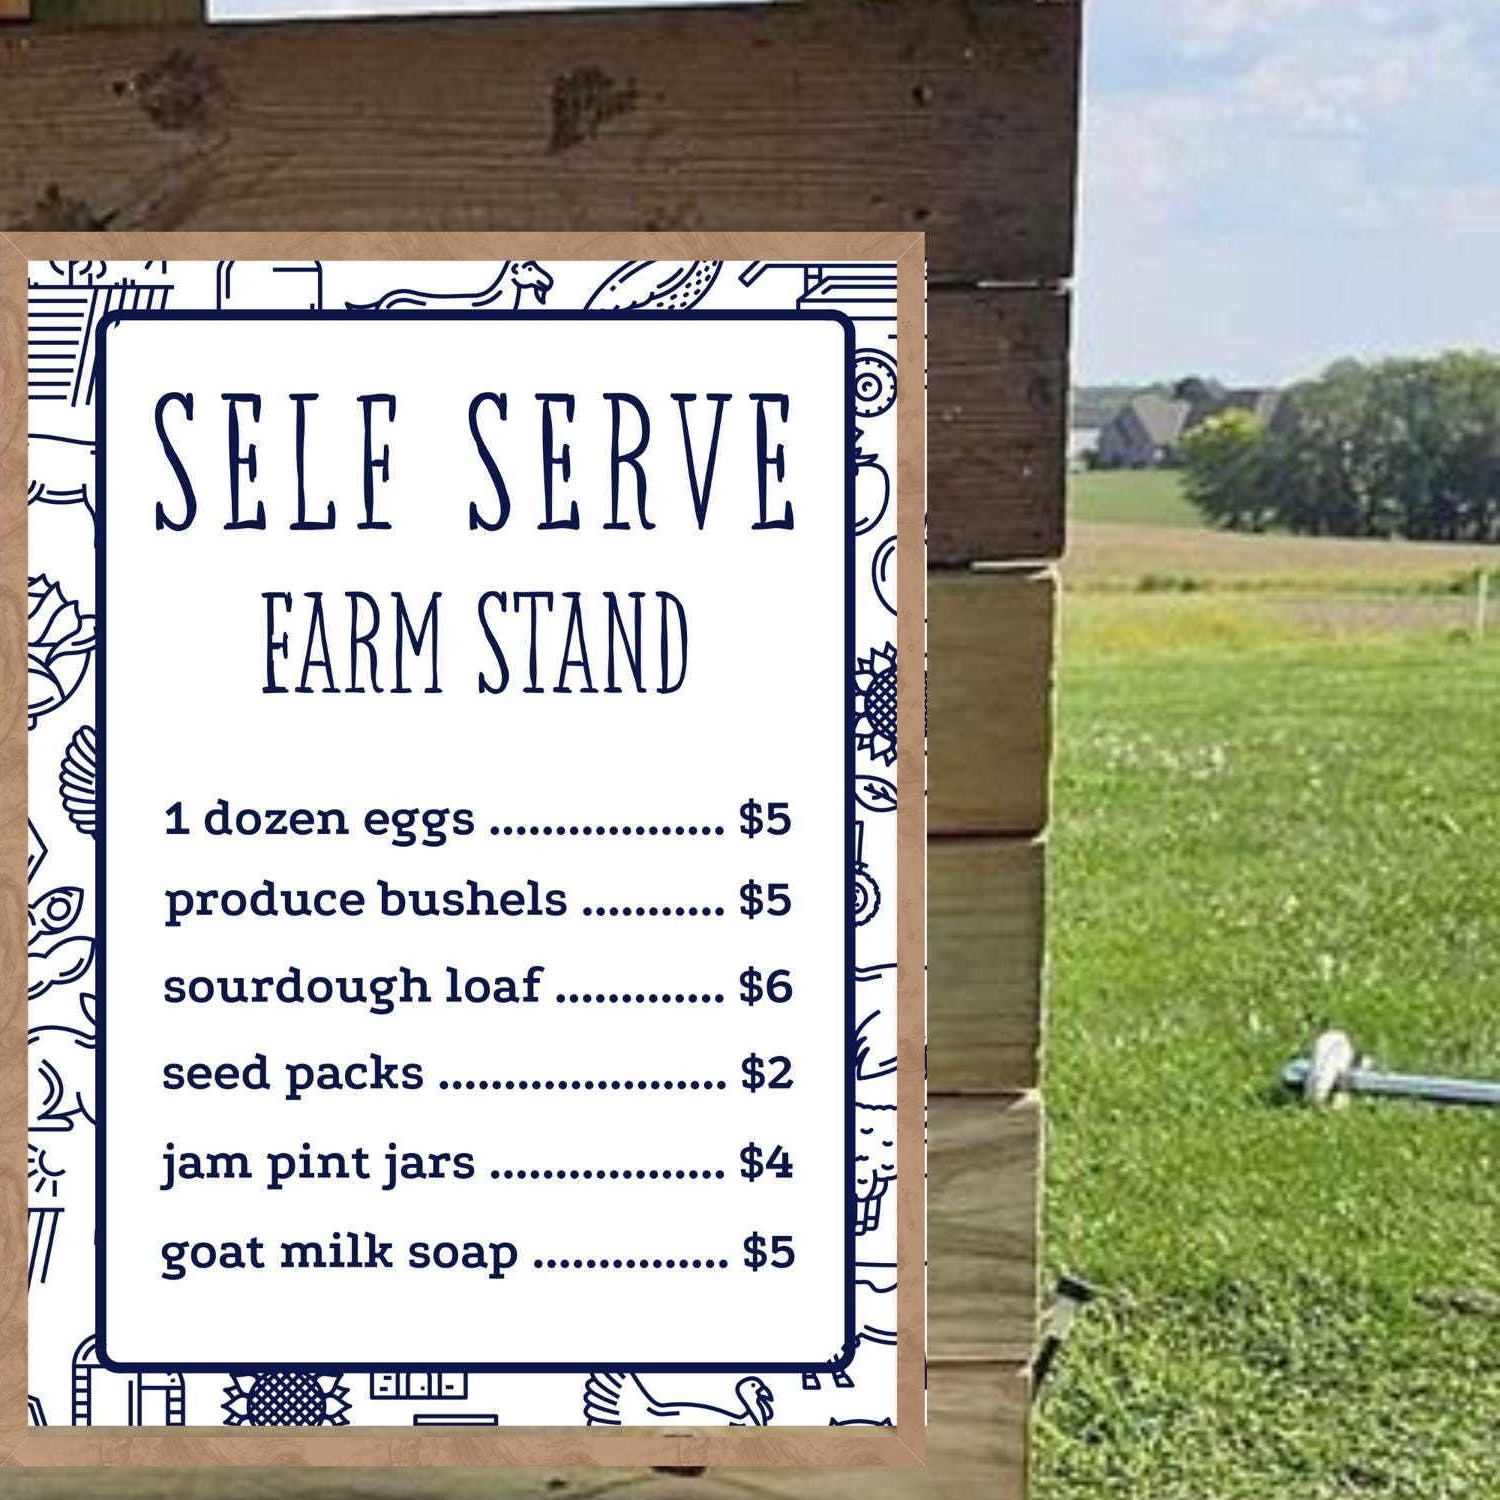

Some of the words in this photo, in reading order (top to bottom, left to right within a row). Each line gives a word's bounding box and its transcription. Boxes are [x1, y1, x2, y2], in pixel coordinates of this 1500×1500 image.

[155, 392, 396, 531] SELF
[469, 392, 794, 531] SERVE
[262, 591, 442, 693] FARM
[478, 591, 687, 694] STAND
[166, 802, 189, 834] 1
[205, 799, 349, 835] dozen
[365, 808, 474, 847] eggs
[740, 798, 791, 838] $5
[165, 880, 364, 926] produce
[377, 880, 567, 916] bushels
[740, 879, 791, 919] $5
[164, 966, 431, 1014] sourdough
[446, 966, 542, 1003] loaf
[740, 966, 792, 1006] $6
[163, 1053, 270, 1089] seed
[286, 1053, 423, 1100] packs
[742, 1053, 793, 1093] $2
[160, 1143, 252, 1190] jam
[267, 1143, 370, 1189] pint
[382, 1143, 474, 1190] jars
[740, 1142, 793, 1182] $4
[162, 1232, 265, 1280] goat
[281, 1232, 393, 1267] milk
[409, 1242, 517, 1279] soap
[744, 1231, 795, 1272] $5
